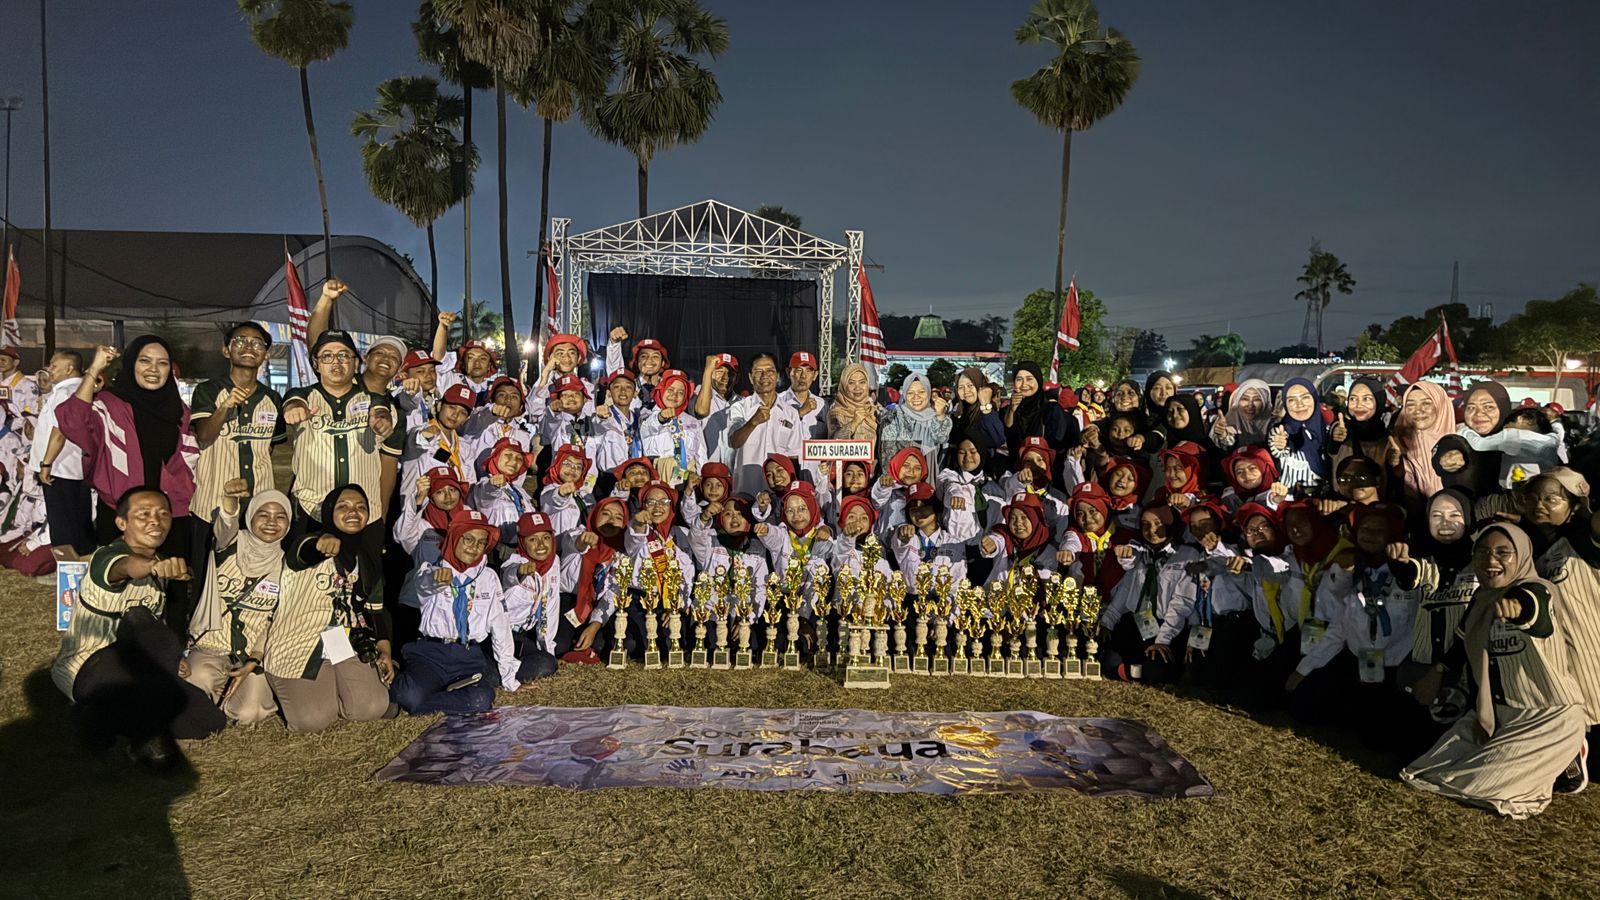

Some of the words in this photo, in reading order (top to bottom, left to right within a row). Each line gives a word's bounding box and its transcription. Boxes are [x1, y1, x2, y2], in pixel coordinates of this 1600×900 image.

[807, 445, 827, 457] KOTA
[829, 445, 868, 457] SURABAYA
[217, 574, 275, 608] Subaya
[679, 728, 854, 740] KONTNGEN
[660, 737, 947, 760] Surabaya
